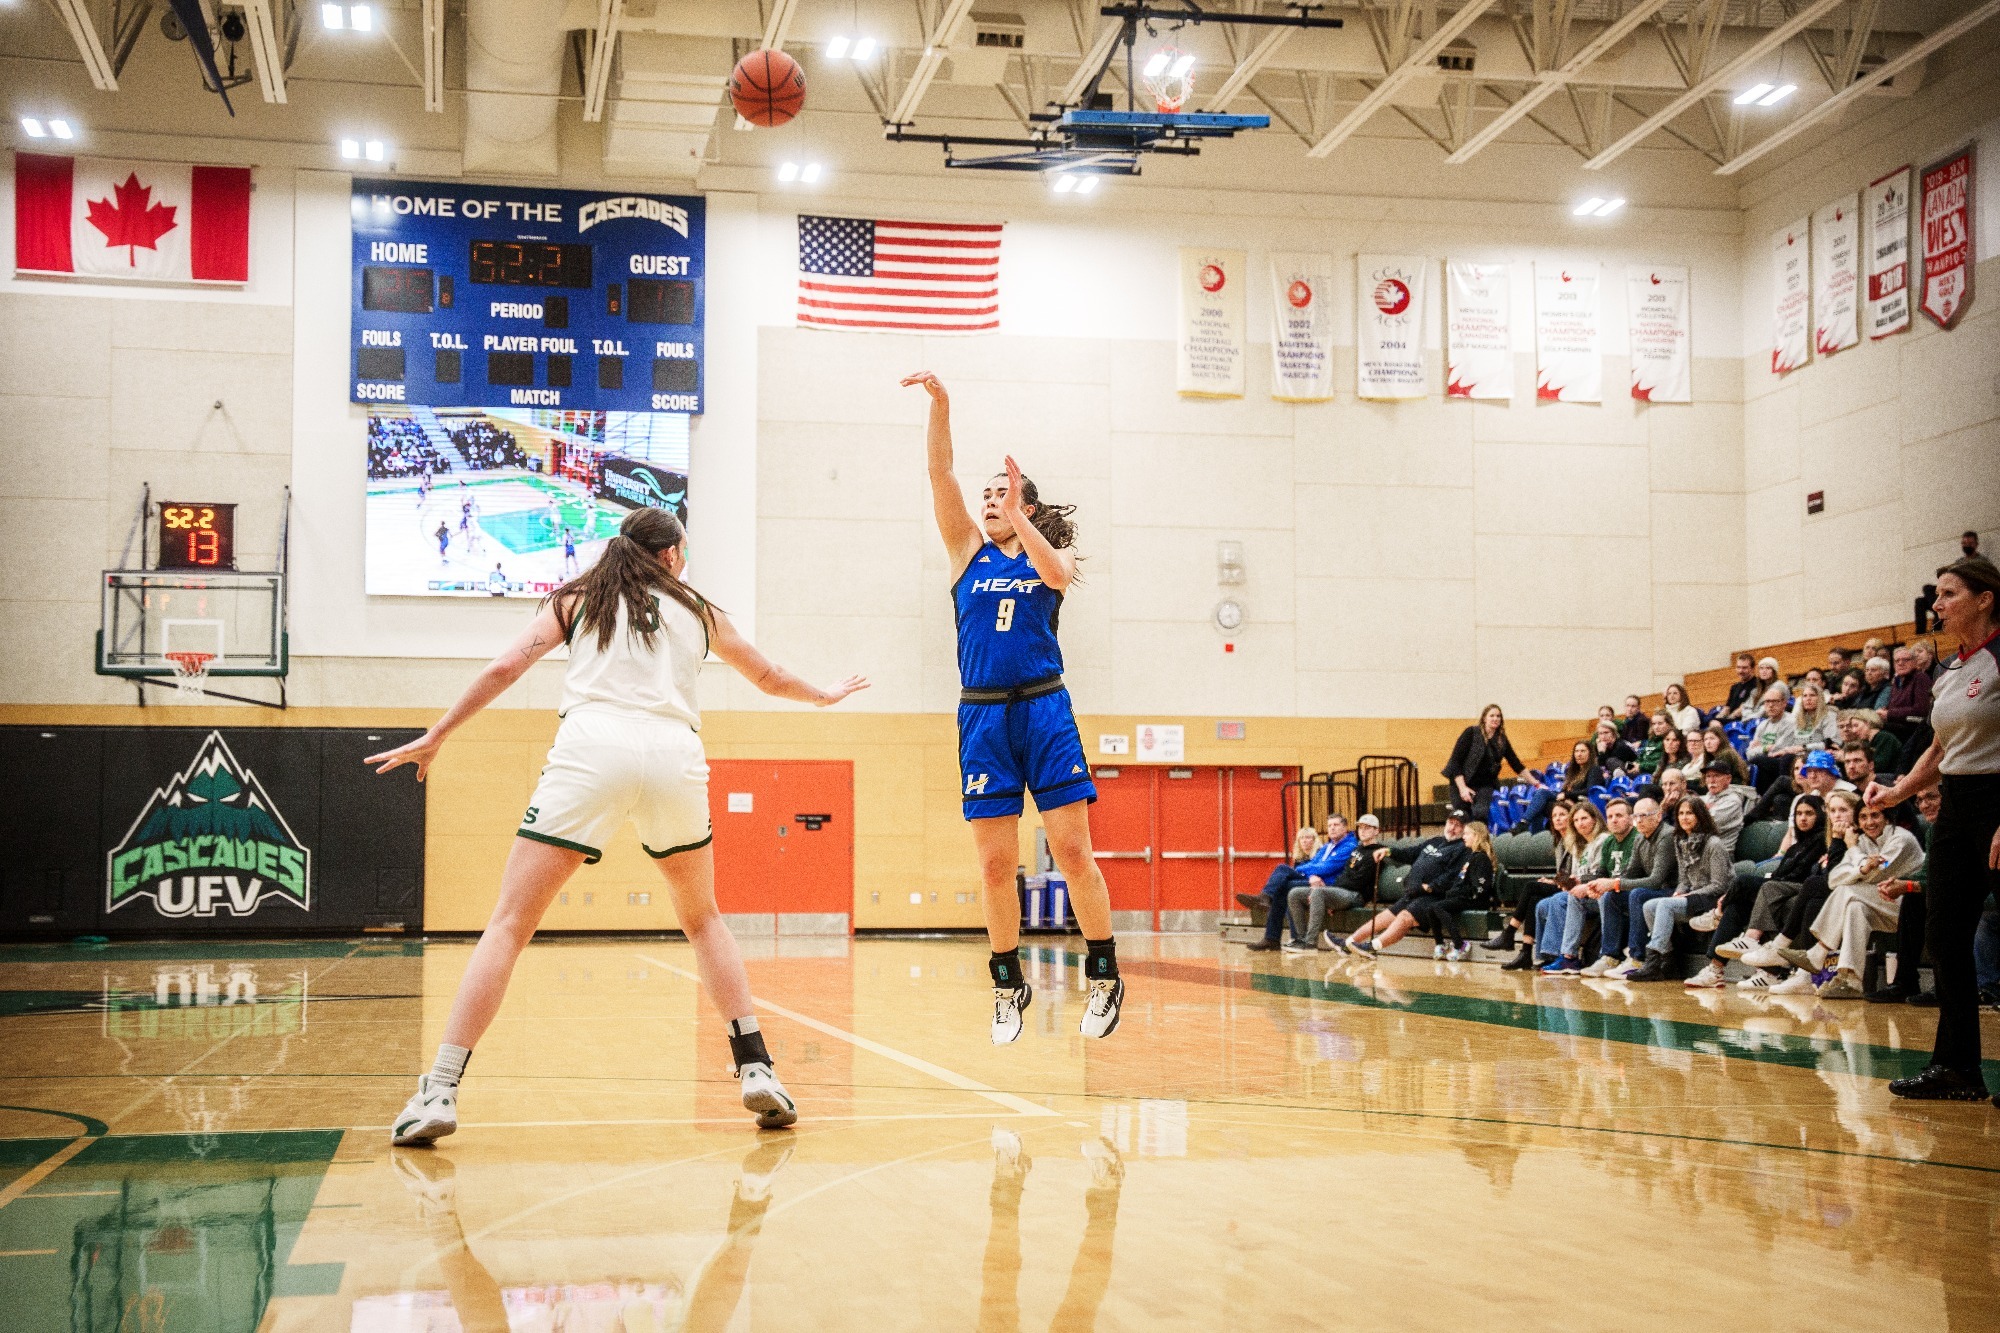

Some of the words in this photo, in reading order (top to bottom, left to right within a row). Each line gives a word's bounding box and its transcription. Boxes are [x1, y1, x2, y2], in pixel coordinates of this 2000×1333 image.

[371, 194, 456, 217] HOME
[461, 199, 501, 219] OF
[505, 201, 563, 223] THE
[578, 196, 689, 239] CASCADES
[371, 241, 428, 264] HOME
[629, 254, 691, 276] GUEST
[490, 302, 544, 319] PERIOD
[362, 330, 402, 346] FOULS
[429, 332, 469, 349] T.O.L.
[483, 335, 538, 352] PLAYER
[541, 337, 579, 354] FOUL
[592, 340, 630, 356] T.O.L.
[656, 342, 694, 358] FOULS
[356, 383, 406, 400] SCORE
[510, 389, 560, 405] MATCH
[651, 394, 699, 411] SCORE
[164, 508, 215, 529] 52.2
[188, 530, 219, 565] 13
[970, 578, 1043, 594] HEAT
[995, 598, 1016, 632] 9
[523, 806, 540, 824] S
[111, 834, 305, 900] CASCADES
[158, 875, 264, 913] UFV
